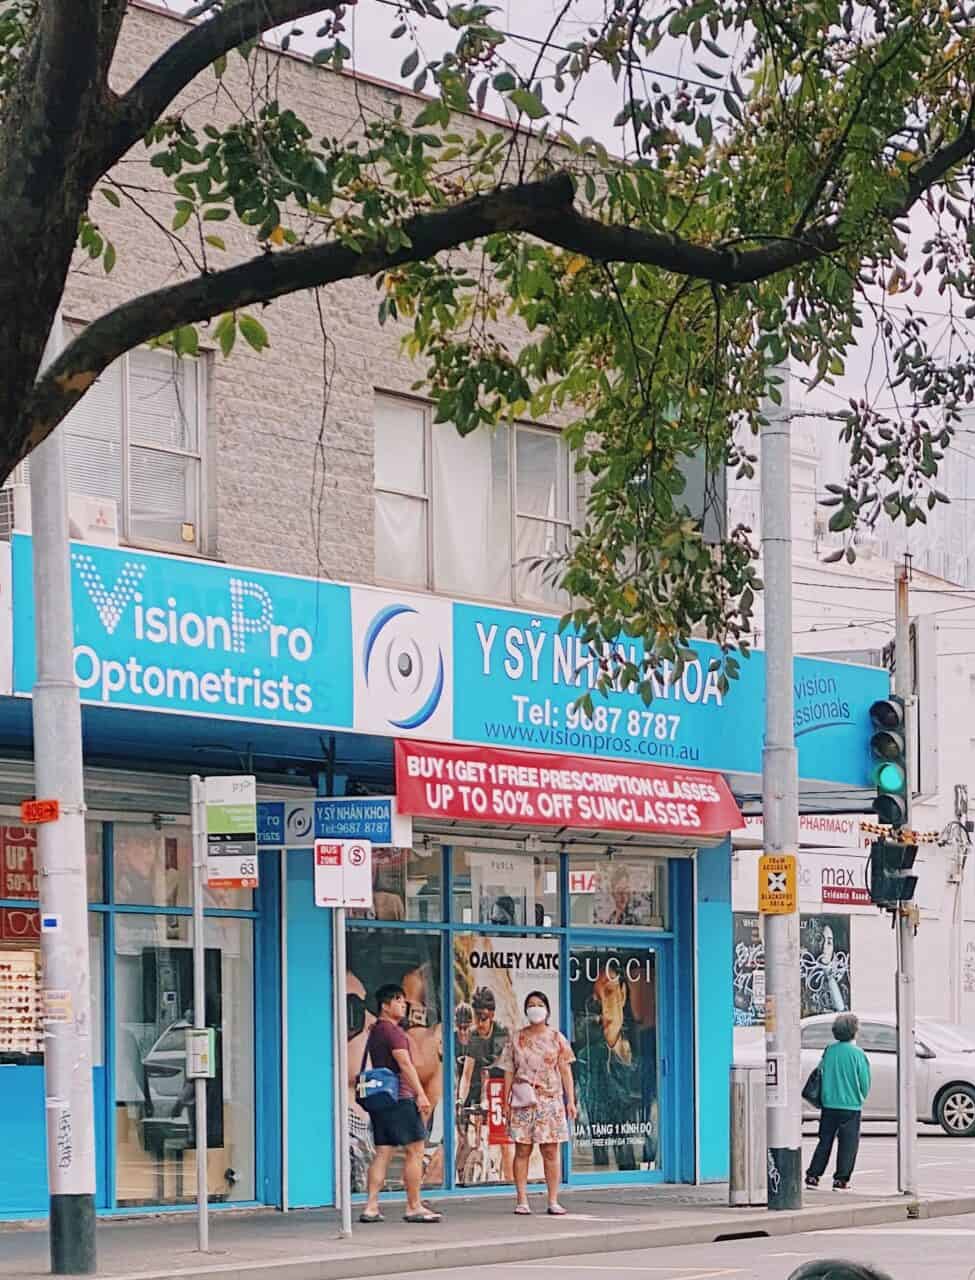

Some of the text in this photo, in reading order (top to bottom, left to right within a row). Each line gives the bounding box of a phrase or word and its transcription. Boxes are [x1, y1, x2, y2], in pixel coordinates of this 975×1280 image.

[71, 553, 313, 661] VisionPro
[475, 621, 499, 676] Y
[72, 645, 313, 713] Optometrists
[793, 676, 838, 700] vision
[511, 694, 559, 728] Tel:
[627, 709, 681, 741] 8787
[484, 720, 700, 761] www.visionpros.com.au
[407, 755, 444, 778] BUY
[455, 763, 489, 783] GET
[498, 765, 539, 788] FREE
[539, 768, 652, 797] PRESCRIPTION
[652, 778, 721, 802] GLASSES
[364, 804, 389, 819] KHOA
[426, 783, 701, 827] UP TO 50% OFF SUNGLASSES
[364, 822, 389, 834] 8787
[799, 815, 855, 834] PHARMACY
[6, 845, 27, 870] UP
[240, 863, 255, 875] 63
[821, 866, 855, 887] max
[469, 951, 523, 970] OAKLEY
[568, 956, 651, 983] GUCCI
